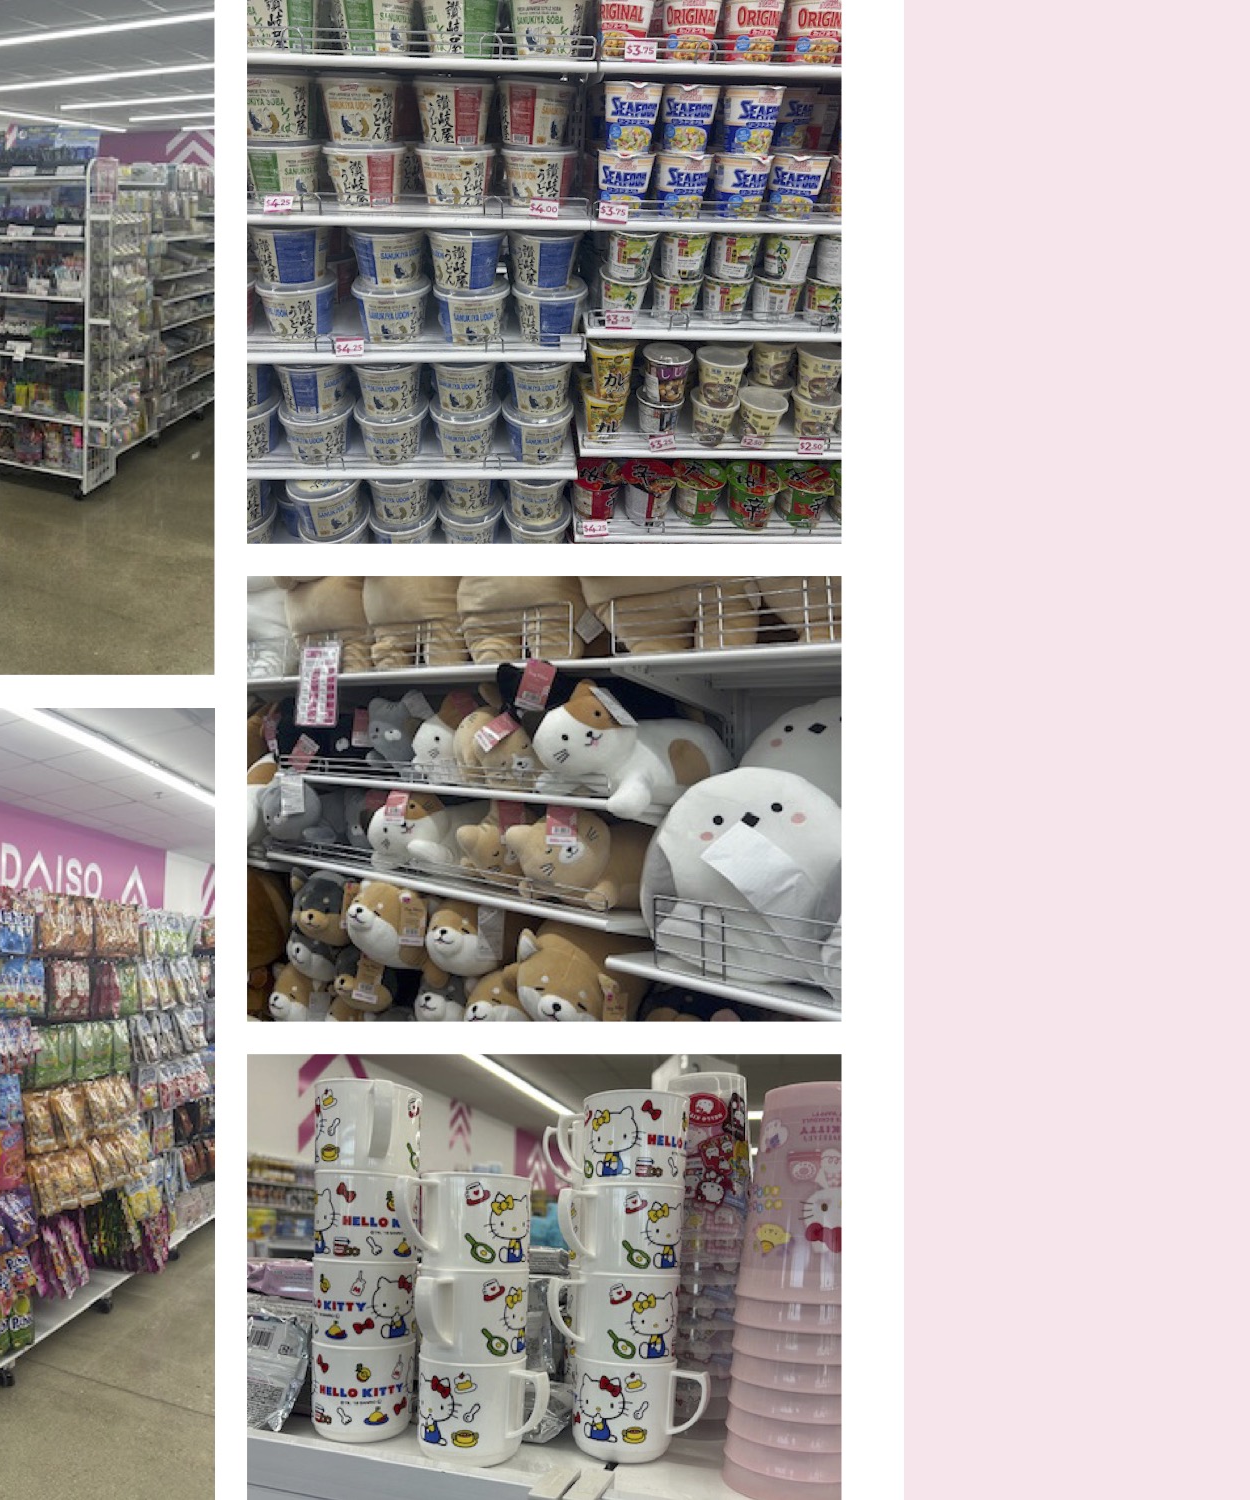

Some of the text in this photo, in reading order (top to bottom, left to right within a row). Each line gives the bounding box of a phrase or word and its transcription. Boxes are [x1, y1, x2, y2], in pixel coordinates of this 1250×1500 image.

[602, 4, 643, 22] RIGINAL
[626, 46, 654, 56] $3.75
[611, 97, 657, 118] SEAFOOD
[664, 97, 712, 118] SEAFOOD
[530, 203, 558, 214] $4.00
[600, 205, 626, 216] $3.75
[606, 313, 630, 325] $3.25
[800, 442, 824, 452] $2.50
[647, 1134, 684, 1149] HELLO
[342, 1215, 389, 1228] HELLO
[323, 1301, 367, 1312] KITTY
[320, 1383, 404, 1398] HELLO KITTY
